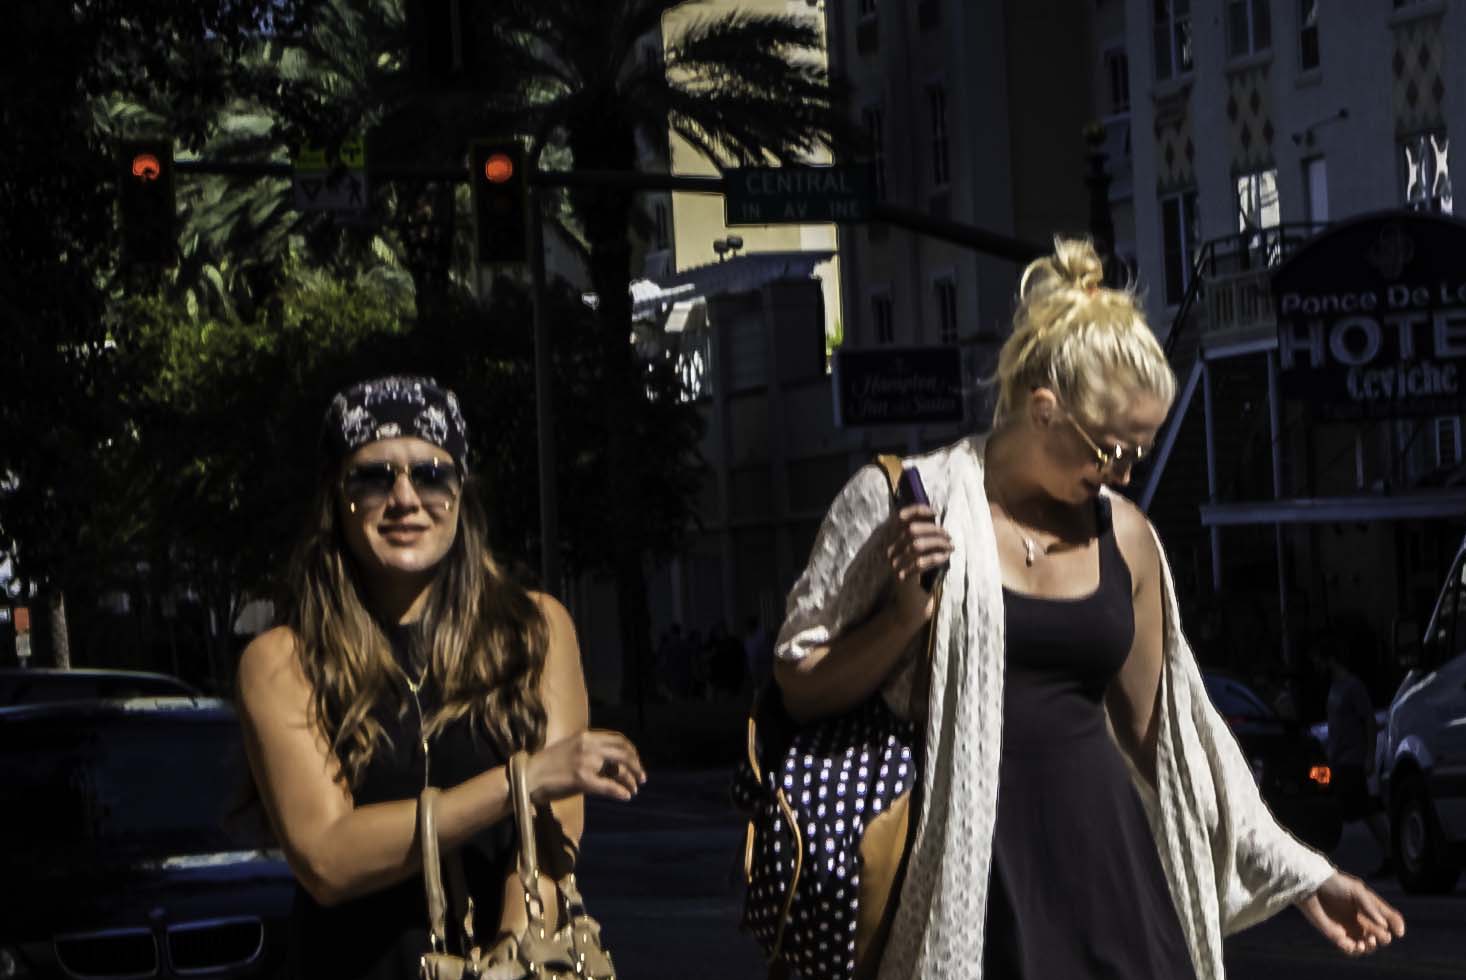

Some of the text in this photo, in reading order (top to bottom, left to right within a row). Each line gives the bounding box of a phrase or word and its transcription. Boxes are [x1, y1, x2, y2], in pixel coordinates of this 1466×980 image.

[745, 170, 854, 196] CENTRAL
[783, 199, 808, 219] AV
[1280, 289, 1377, 316] Ponce
[1387, 283, 1431, 310] De
[1345, 360, 1459, 402] Ceviche
